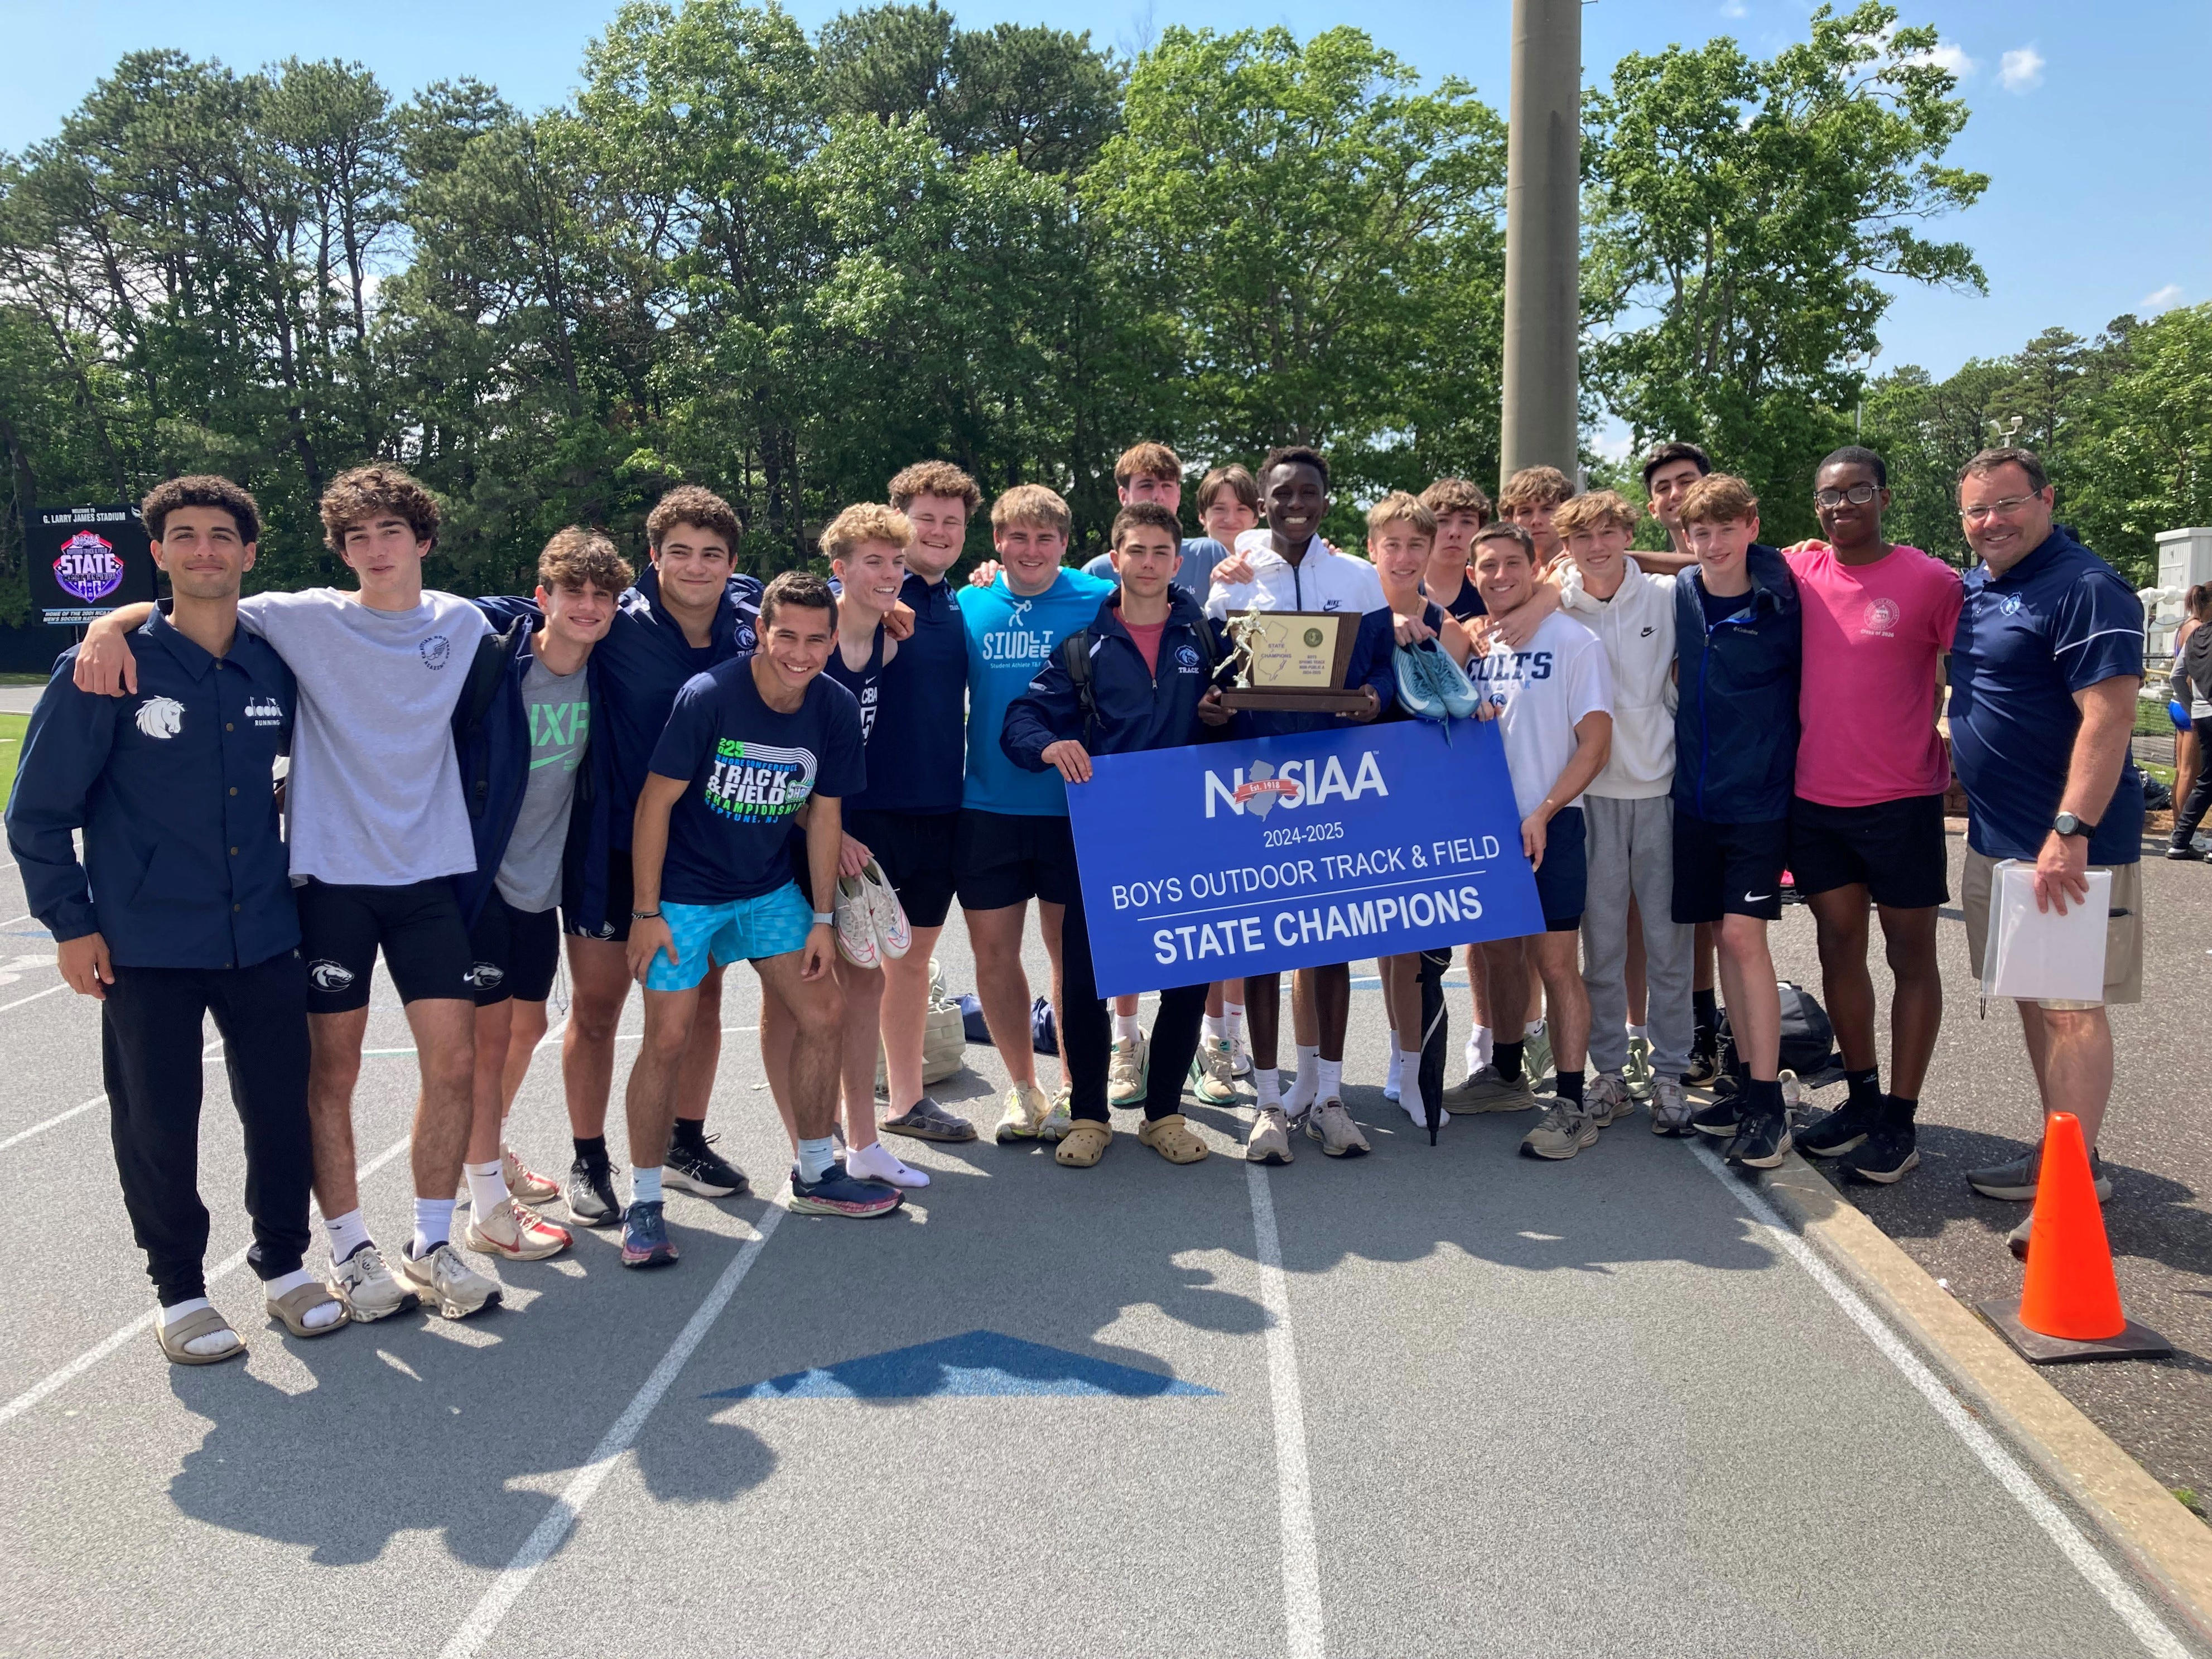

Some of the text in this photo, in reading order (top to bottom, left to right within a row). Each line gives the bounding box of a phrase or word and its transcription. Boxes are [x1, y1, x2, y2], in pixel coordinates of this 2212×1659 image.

[43, 512, 126, 524] G. LARRY JAMES STADIUM
[60, 553, 116, 574] STATE
[1466, 652, 1552, 681] COLTS
[714, 760, 789, 789] TRACK
[716, 754, 798, 772] SHORE CONFERENCE
[721, 782, 786, 805] FIELD
[704, 797, 760, 823] NEPTUNE,
[1263, 821, 1344, 847] 2024-2025
[1112, 835, 1500, 910] BOYS OUTDOOR TRACK & FIELD
[1153, 886, 1483, 964] STATE CHAMPIONS
